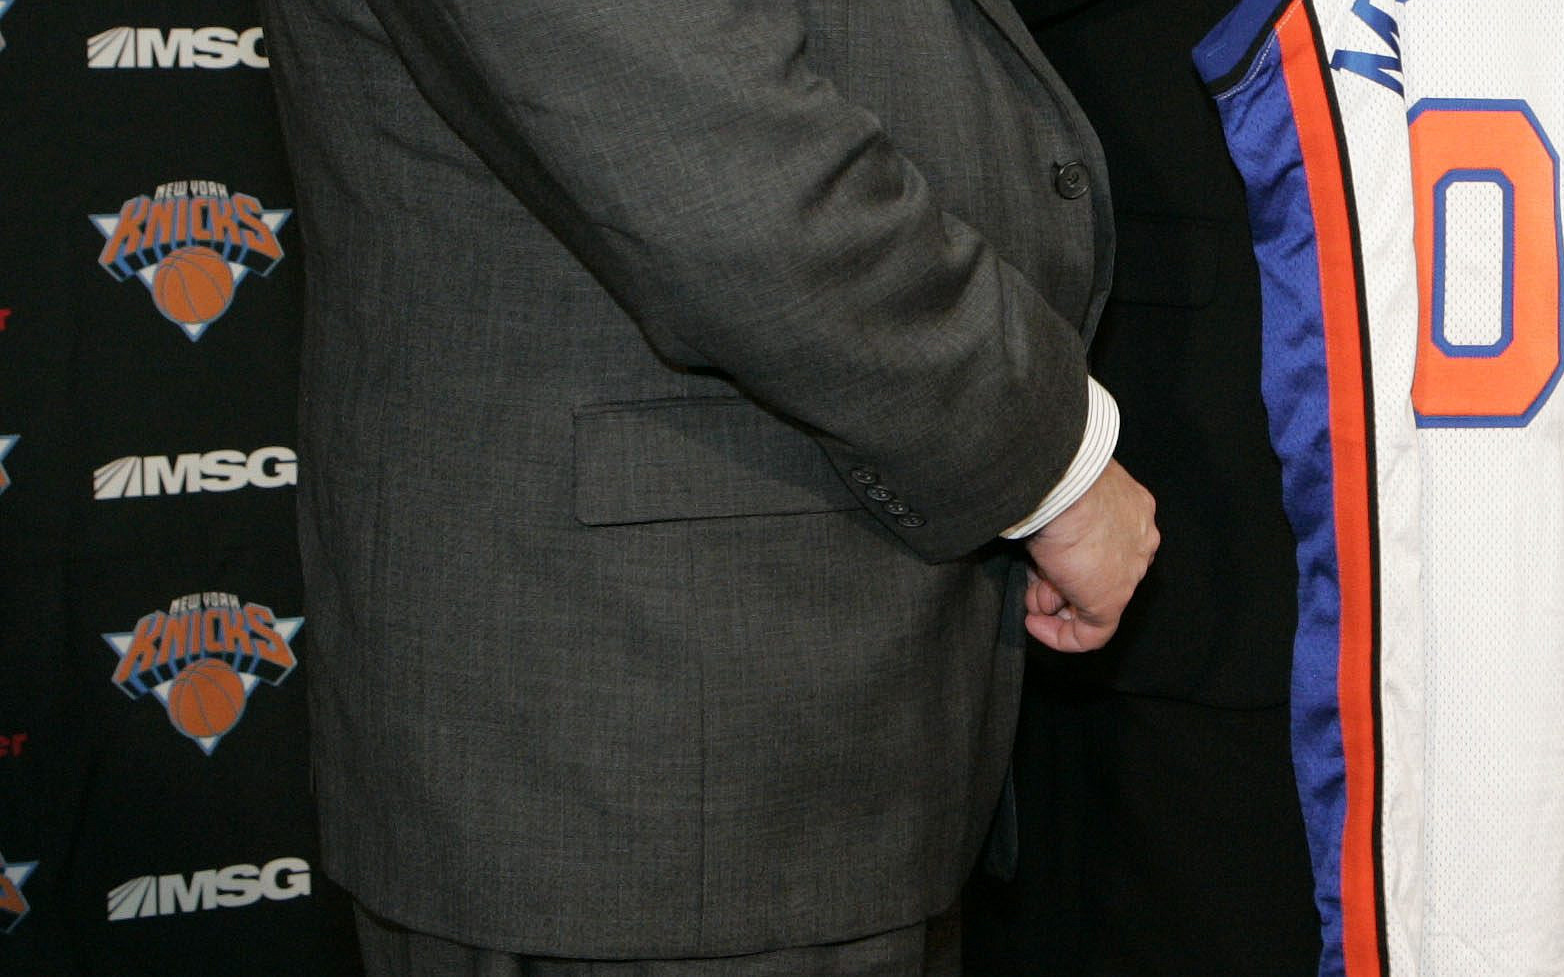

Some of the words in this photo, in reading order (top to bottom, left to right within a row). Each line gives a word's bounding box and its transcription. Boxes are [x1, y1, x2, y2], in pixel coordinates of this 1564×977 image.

[154, 181, 188, 199] NEW
[190, 180, 228, 199] YORK
[99, 193, 284, 265] KNICKS
[143, 446, 298, 497] MSG
[169, 593, 200, 615] NEW
[203, 592, 240, 609] YORK
[112, 602, 297, 686] KNICKS
[158, 857, 311, 916] MSG
